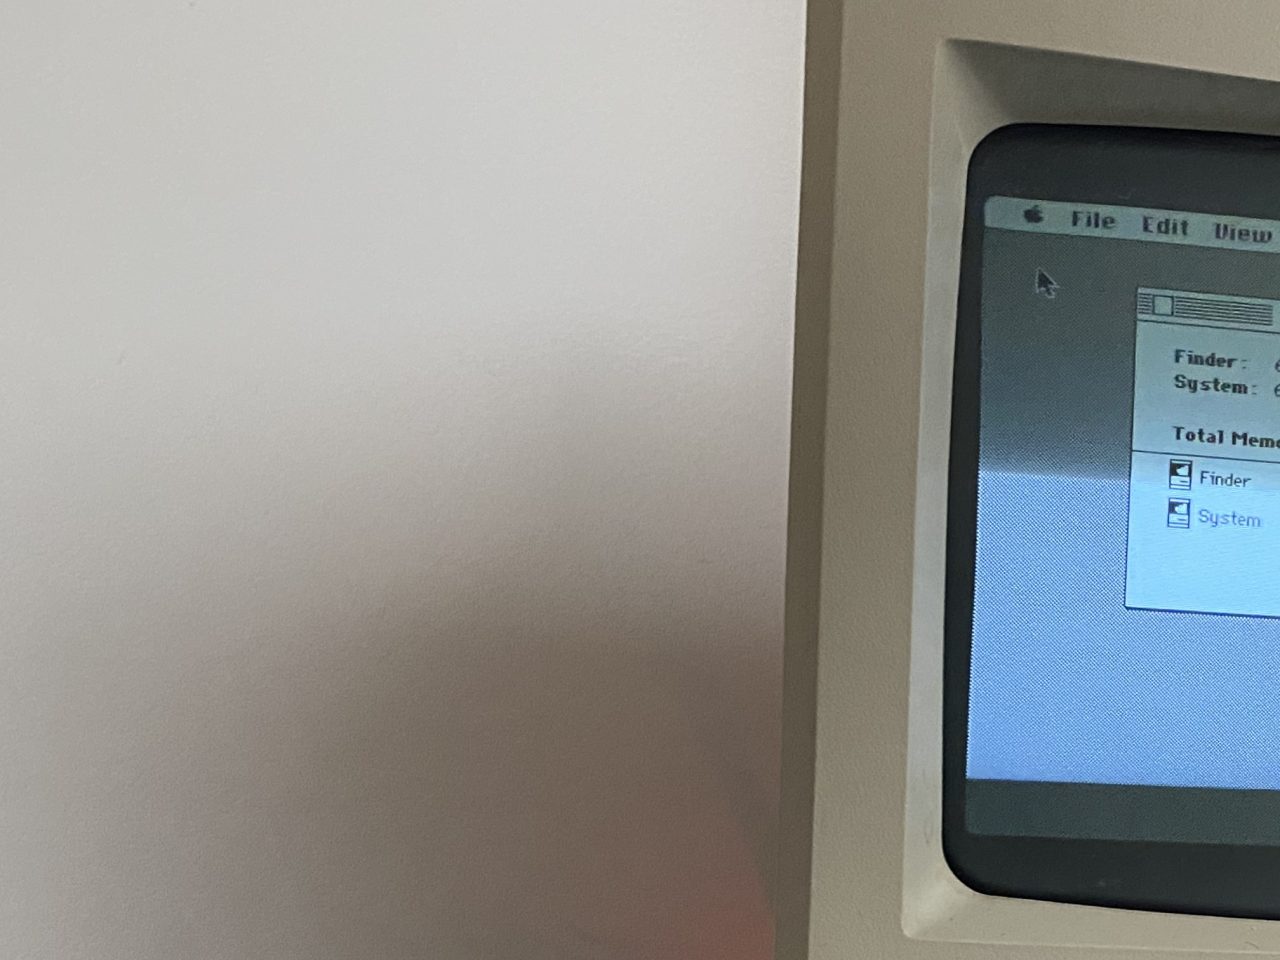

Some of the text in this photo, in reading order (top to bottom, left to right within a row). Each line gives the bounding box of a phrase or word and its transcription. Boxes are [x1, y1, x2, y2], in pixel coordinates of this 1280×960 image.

[1072, 210, 1116, 231] File
[1142, 215, 1189, 237] Edit
[1214, 222, 1273, 244] View
[1174, 349, 1248, 371] Finder:
[1174, 374, 1258, 397] System:
[1172, 425, 1225, 445] Total
[1199, 470, 1252, 489] Finder
[1198, 508, 1262, 529] System
